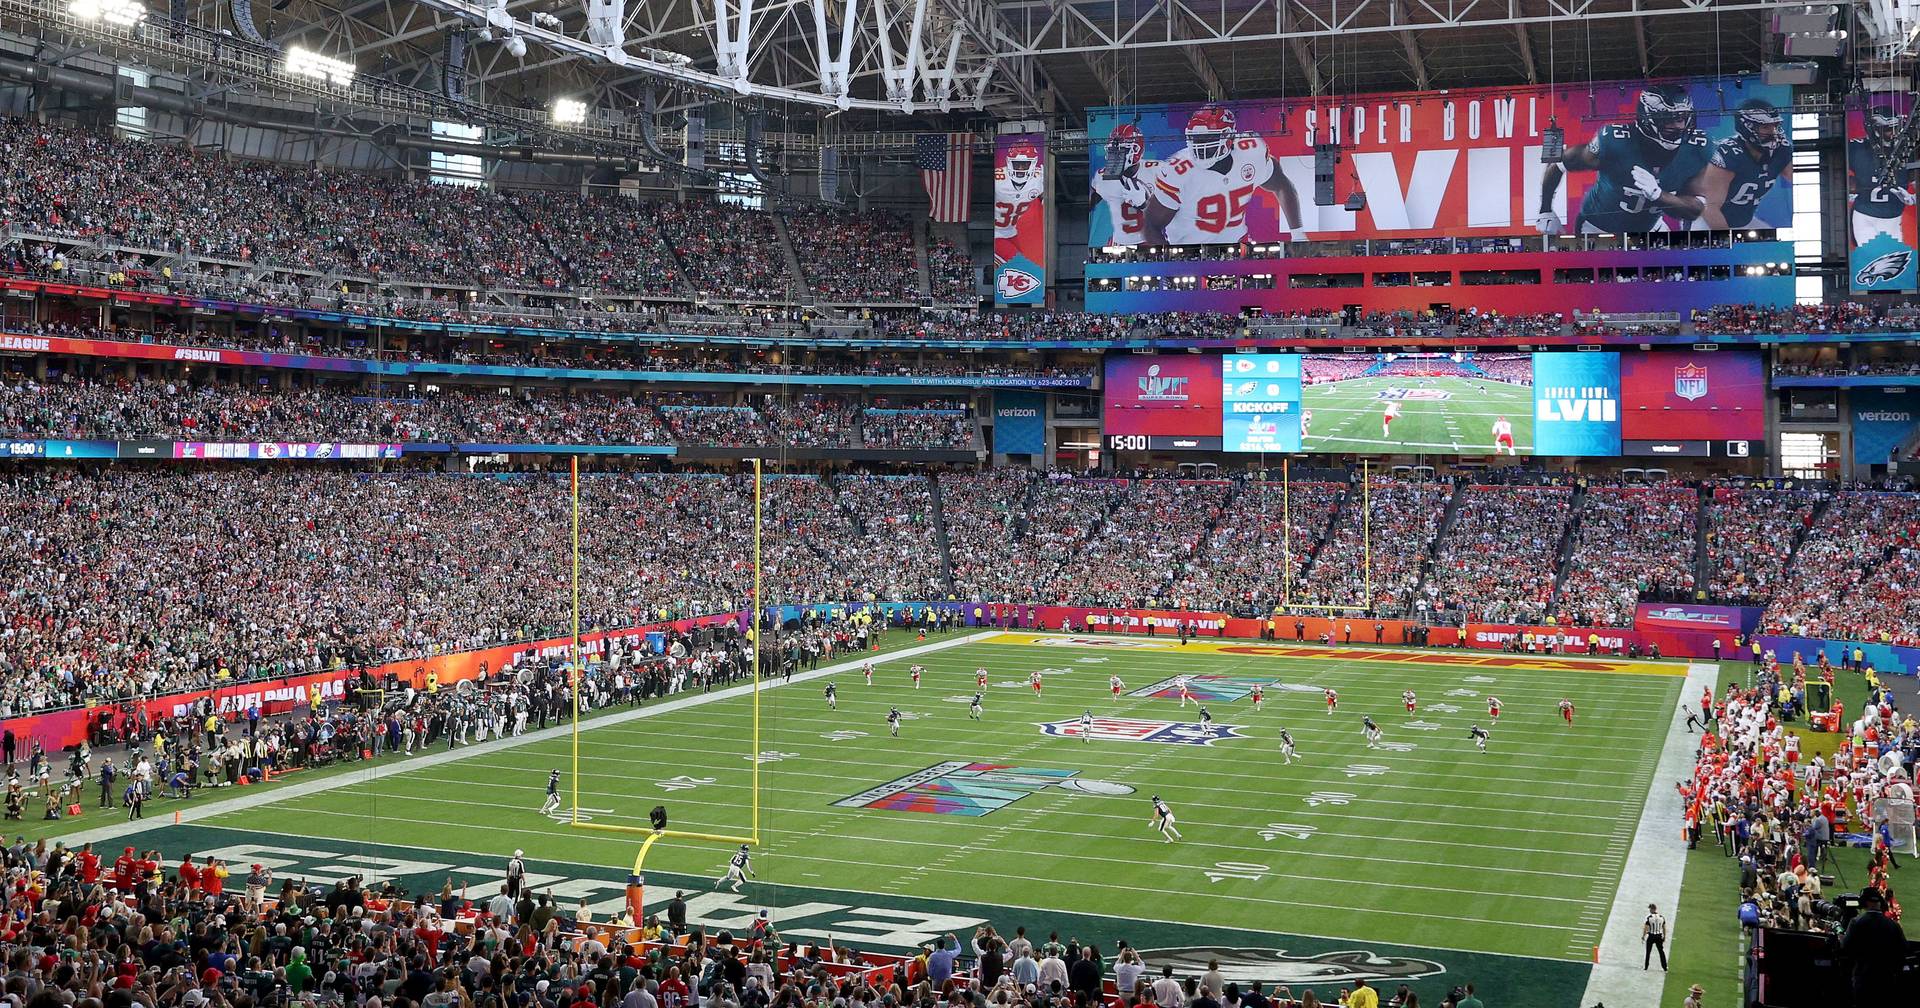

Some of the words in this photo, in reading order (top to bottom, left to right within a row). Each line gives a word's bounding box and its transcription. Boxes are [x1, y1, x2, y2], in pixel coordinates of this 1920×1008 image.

[1305, 103, 1411, 147] SUPER
[1443, 97, 1538, 141] BOWL
[1279, 145, 1567, 233] LVII
[1195, 183, 1254, 234] 95
[1007, 275, 1030, 291] KC
[0, 338, 50, 350] LEAGUE
[174, 348, 220, 362] #SBLVII
[1679, 380, 1705, 392] NFL
[1545, 387, 1575, 398] SUPER
[1581, 387, 1608, 398] BOWL
[998, 407, 1036, 417] verizon
[1233, 402, 1288, 413] KICKOFF
[1538, 400, 1616, 421] LVII
[1858, 410, 1910, 421] verizon
[10, 443, 35, 454] 15:00
[38, 445, 43, 453] 6
[1110, 436, 1146, 450] 15:00
[1737, 443, 1746, 455] 6
[288, 444, 306, 457] VS
[1217, 647, 1630, 671] CHIEFS
[118, 864, 127, 876] 15
